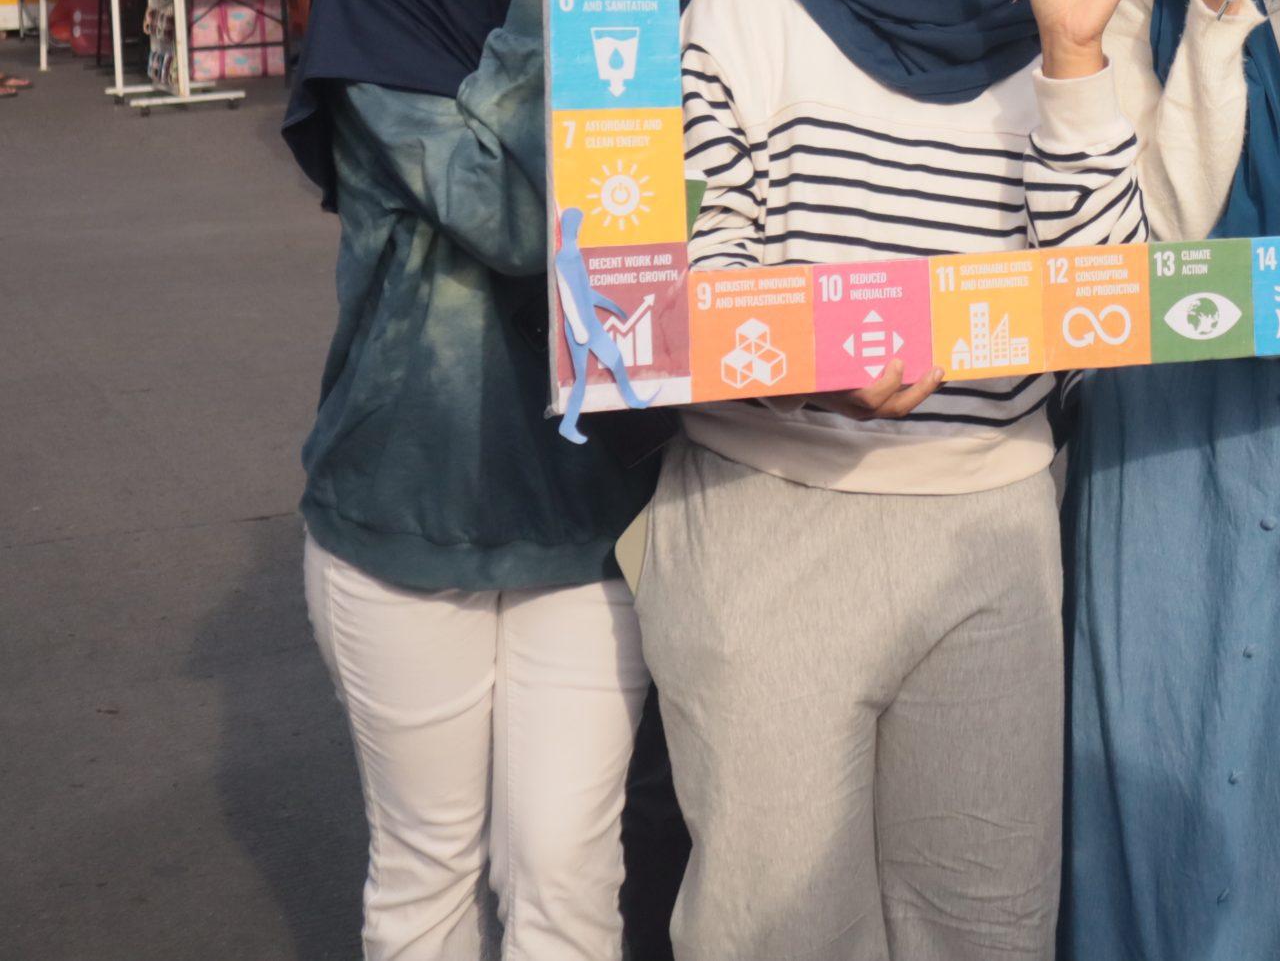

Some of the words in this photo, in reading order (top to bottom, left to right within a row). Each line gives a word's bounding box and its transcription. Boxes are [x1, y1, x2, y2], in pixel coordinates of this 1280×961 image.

[582, 1, 602, 12] AND
[605, 0, 658, 12] SANITATION
[585, 120, 640, 132] AFFORDABLE
[643, 118, 662, 130] AND
[562, 121, 576, 149] 7
[585, 136, 614, 147] CLEAN
[616, 135, 649, 147] ENERGY
[589, 257, 622, 270] DECENT
[625, 255, 651, 267] WORK
[653, 254, 672, 265] AND
[1074, 254, 1124, 268] RESPONSIBLE
[1181, 249, 1212, 261] CLIMATE
[1256, 246, 1278, 271] 14
[960, 261, 1008, 276] SUSTAINABLE
[1010, 260, 1033, 272] CITIES
[1047, 257, 1069, 284] 12
[1154, 250, 1175, 277] 13
[1182, 263, 1208, 275] ACTION
[590, 272, 637, 286] ECONOMIC
[639, 270, 678, 283] GROWTH
[850, 272, 887, 285] REDUCED
[936, 266, 955, 292] 11
[960, 278, 976, 289] AND
[977, 275, 1029, 289] COMMUNITIES
[1075, 268, 1129, 283] CONSUMPTION
[759, 277, 806, 290] INNOVATION
[819, 274, 843, 302] 10
[1076, 286, 1092, 297] AND
[1092, 283, 1140, 297] PRODUCTION
[697, 282, 712, 311] 9
[716, 297, 732, 309] AND
[735, 293, 806, 308] INFRASTRUCTURE
[850, 286, 903, 301] INEQUALITIES
